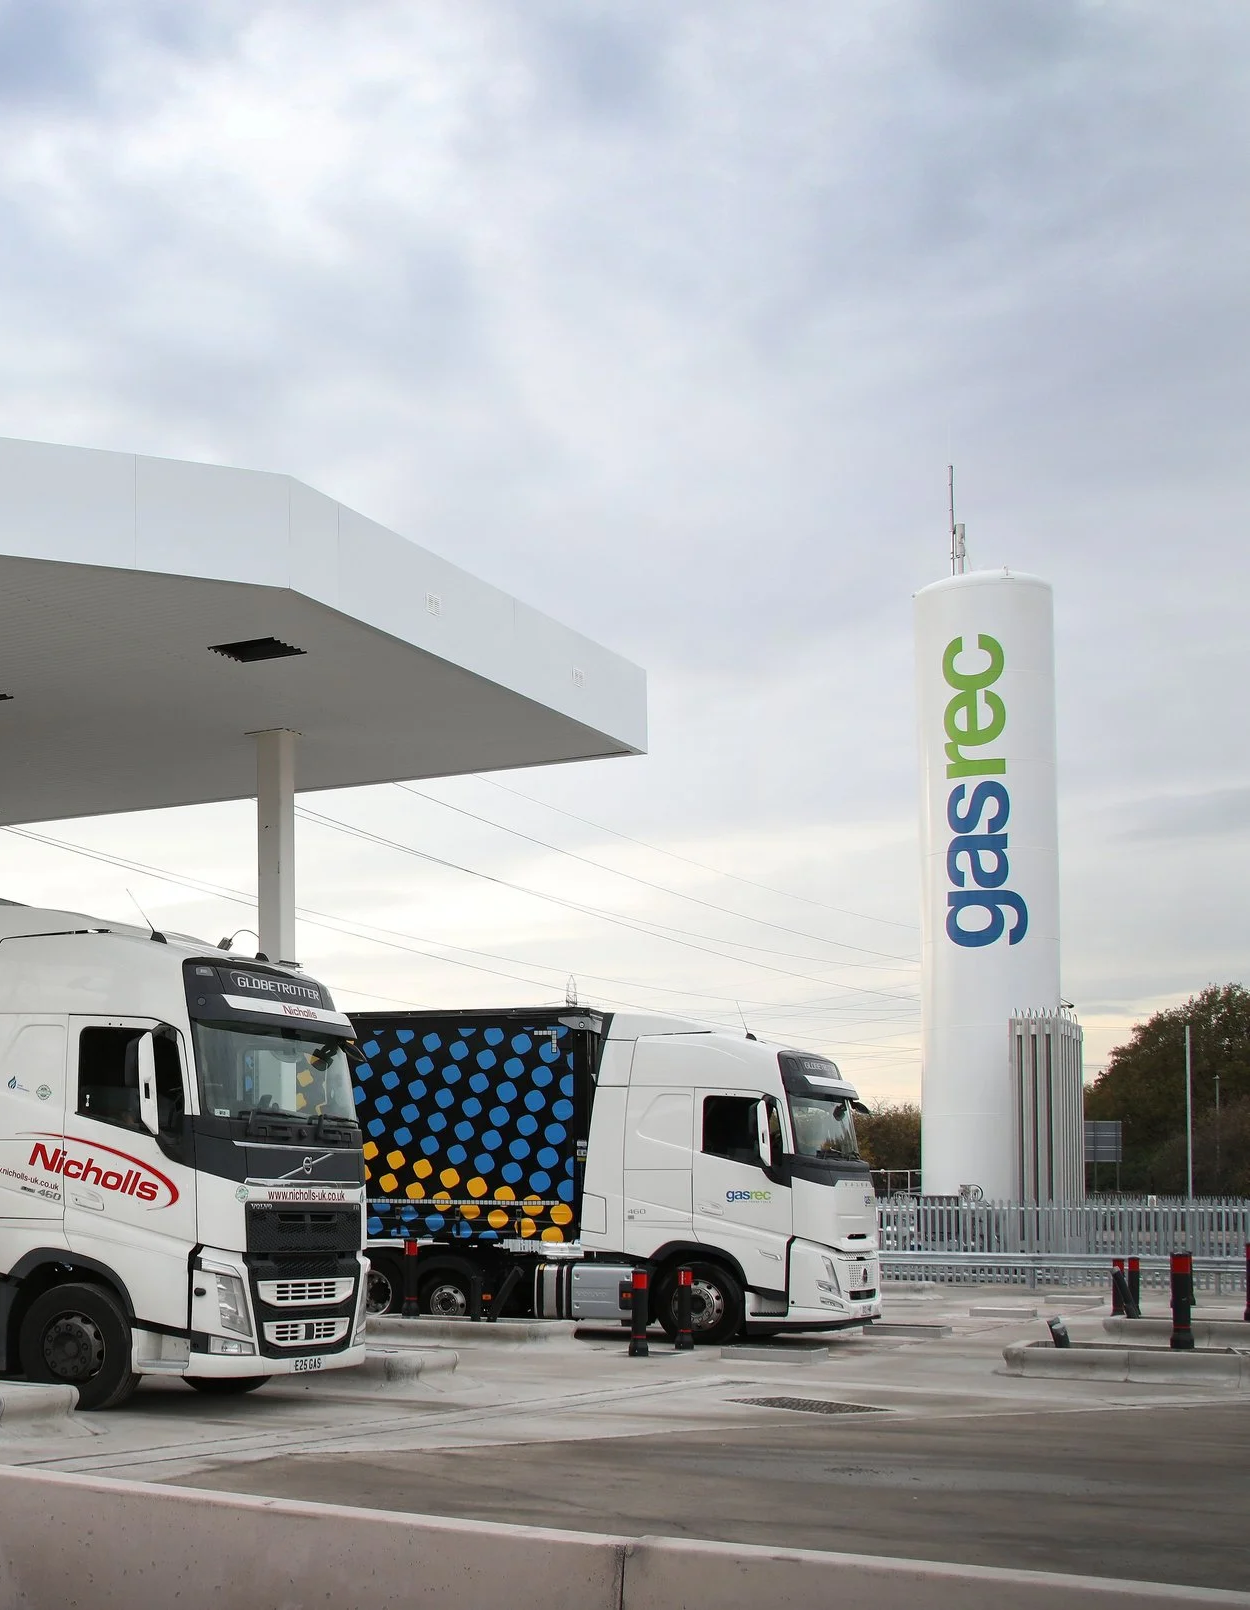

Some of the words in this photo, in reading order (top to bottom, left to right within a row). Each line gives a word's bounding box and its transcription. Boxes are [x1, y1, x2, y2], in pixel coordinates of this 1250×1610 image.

[942, 633, 1029, 948] gasrec
[237, 976, 320, 1000] GLOBETROTTER
[282, 1004, 318, 1019] Nicholls
[28, 1142, 159, 1202] Nicholls
[37, 1189, 62, 1201] 460
[267, 1188, 346, 1201] www.nicholls-uk.co.uk
[726, 1190, 771, 1203] gasrec
[294, 1359, 308, 1371] E25
